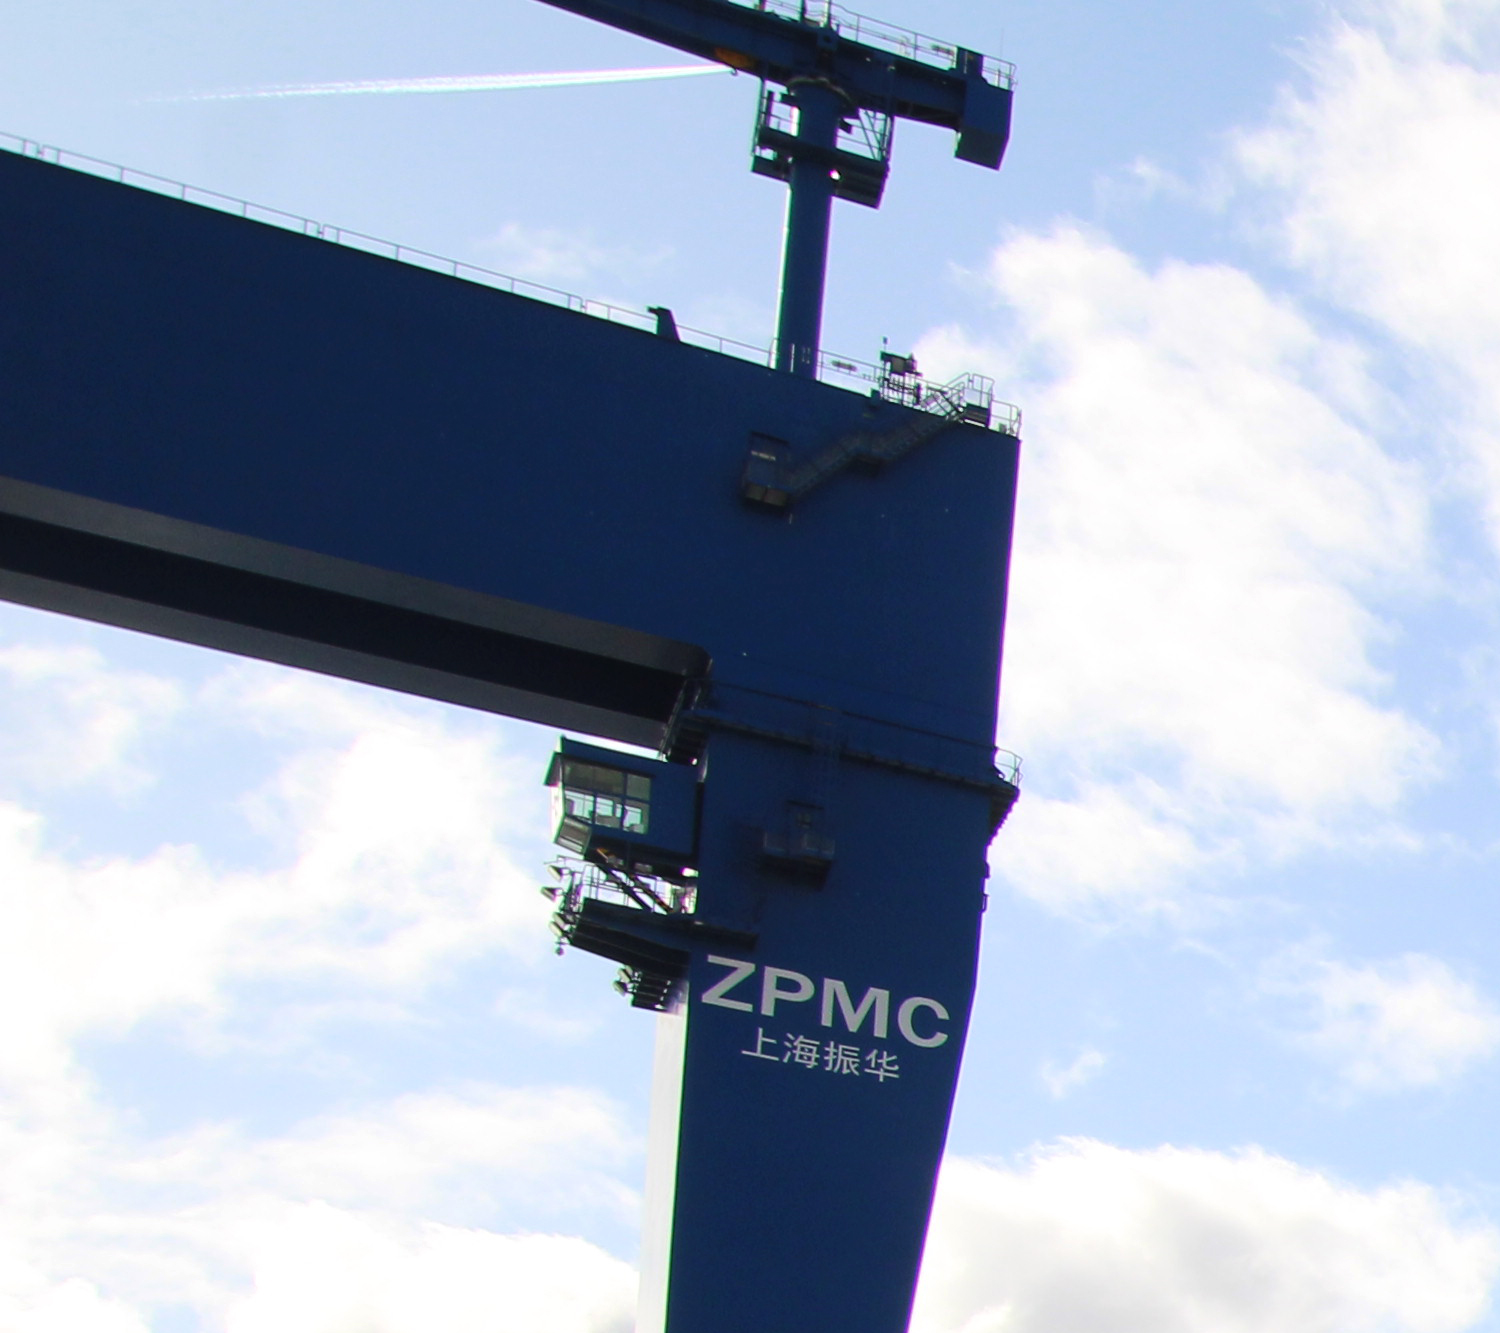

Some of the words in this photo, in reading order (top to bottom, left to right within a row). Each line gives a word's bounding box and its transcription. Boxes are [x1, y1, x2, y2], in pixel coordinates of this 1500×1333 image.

[701, 954, 950, 1048] ZPMC
[741, 1027, 900, 1082] 上海振华
